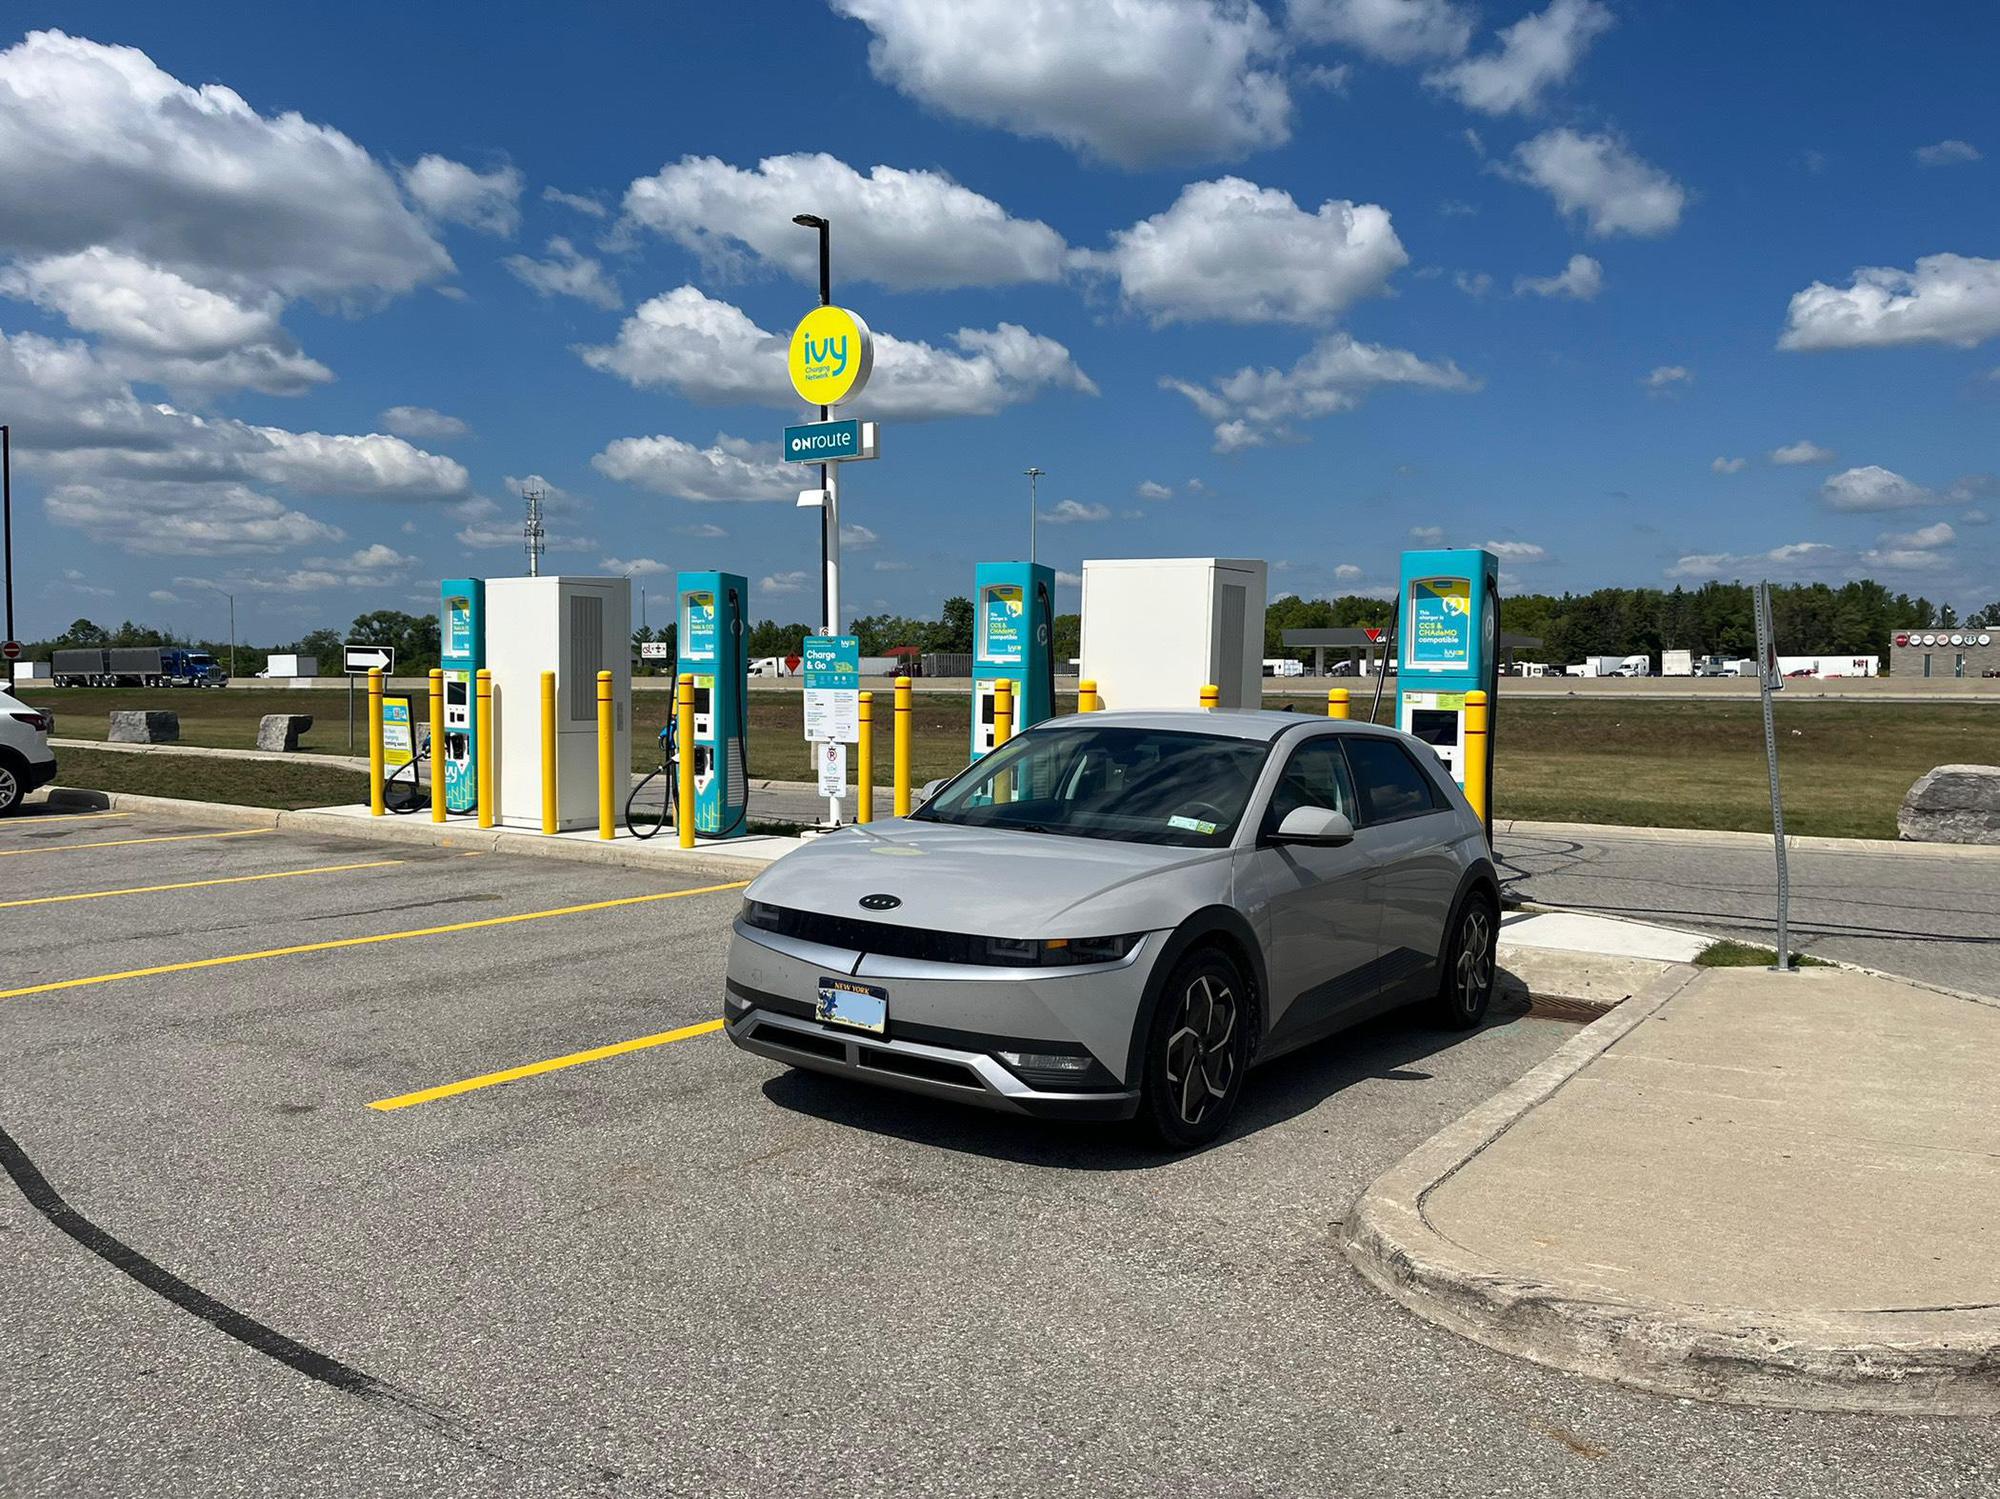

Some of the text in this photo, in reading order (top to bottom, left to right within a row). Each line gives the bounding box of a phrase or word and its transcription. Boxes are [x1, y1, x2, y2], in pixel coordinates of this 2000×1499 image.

[804, 332, 847, 376] ivy
[805, 365, 830, 374] Charging
[805, 372, 829, 381] Network
[806, 650, 836, 661] Charge
[806, 661, 827, 670] & Go
[835, 982, 869, 994] NEW YORK
